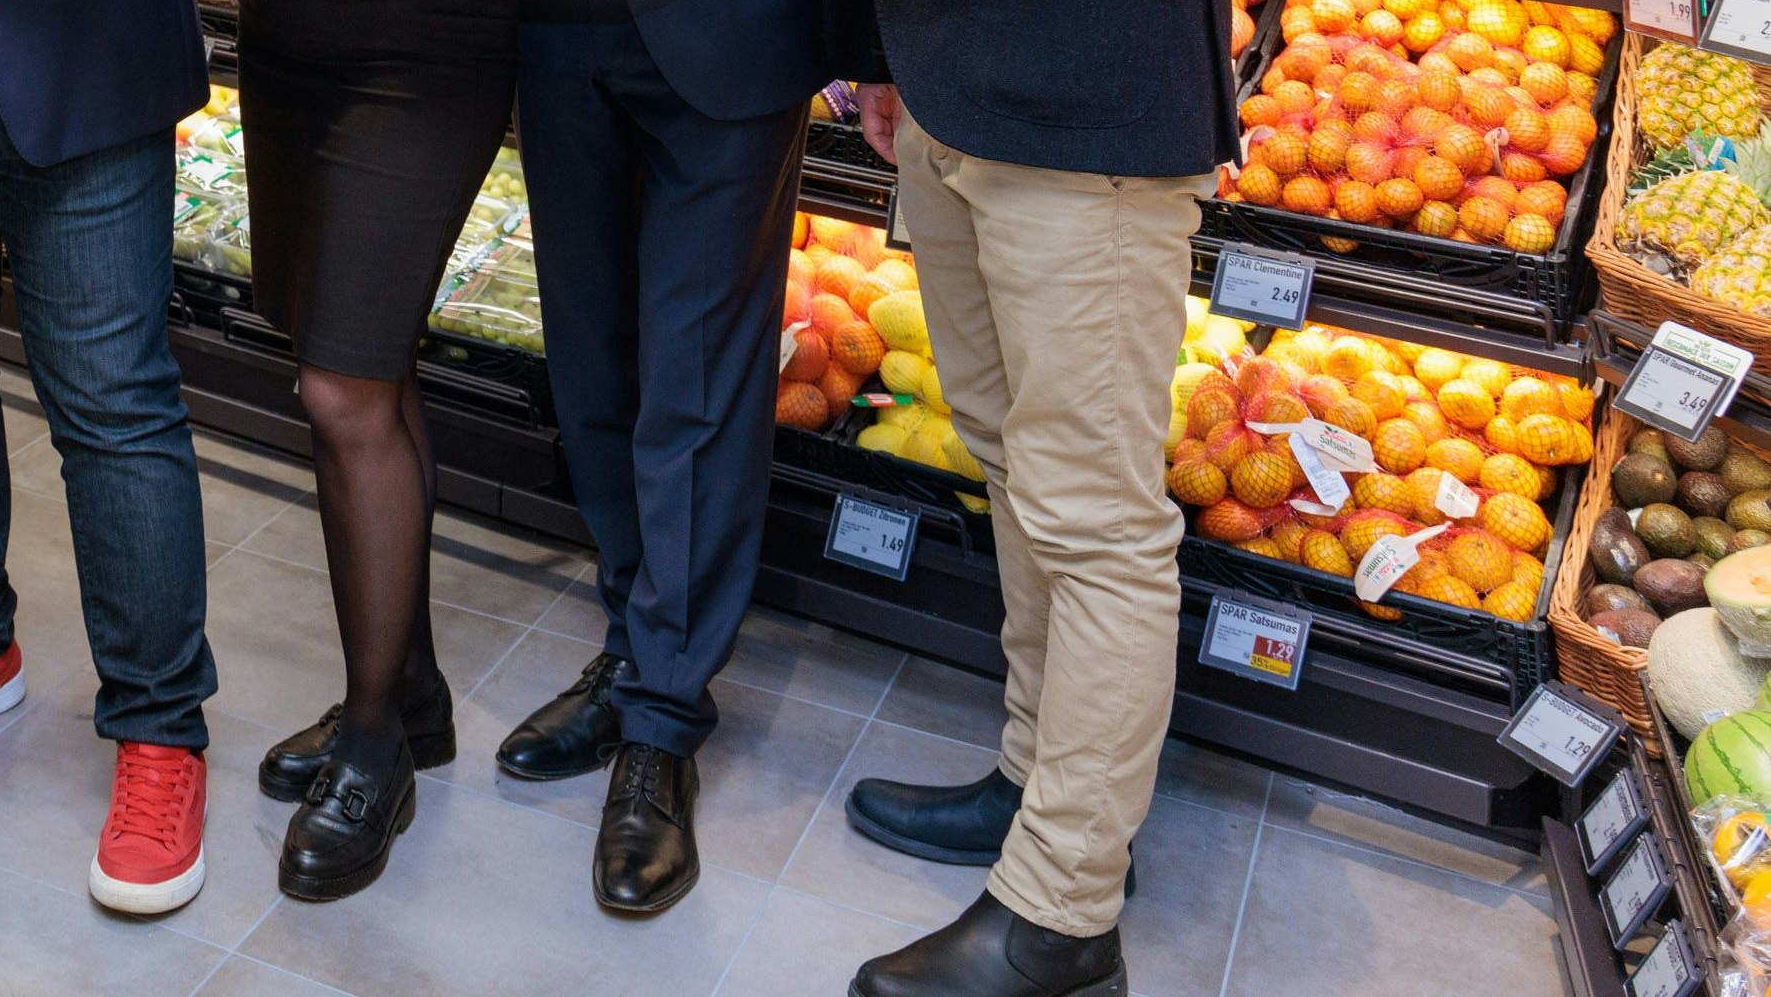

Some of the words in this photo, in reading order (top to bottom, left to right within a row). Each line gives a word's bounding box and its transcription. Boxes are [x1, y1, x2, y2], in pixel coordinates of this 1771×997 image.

[1669, 1, 1691, 19] 1.99
[1229, 256, 1252, 271] SPAR
[1254, 261, 1303, 280] Clementine
[1272, 286, 1299, 304] 2.49
[1679, 391, 1708, 412] 3.49
[1319, 434, 1356, 460] Satsumas
[843, 500, 878, 517] S-BUDGET
[879, 509, 906, 526] Zitronen
[881, 533, 904, 552] 1.49
[1220, 603, 1248, 621] SPAR
[1249, 612, 1297, 635] Satsumas
[1266, 639, 1295, 661] 1.29
[1540, 692, 1578, 717] S-BUDGET
[1575, 712, 1605, 734] Avocado
[1564, 735, 1591, 757] 1.29
